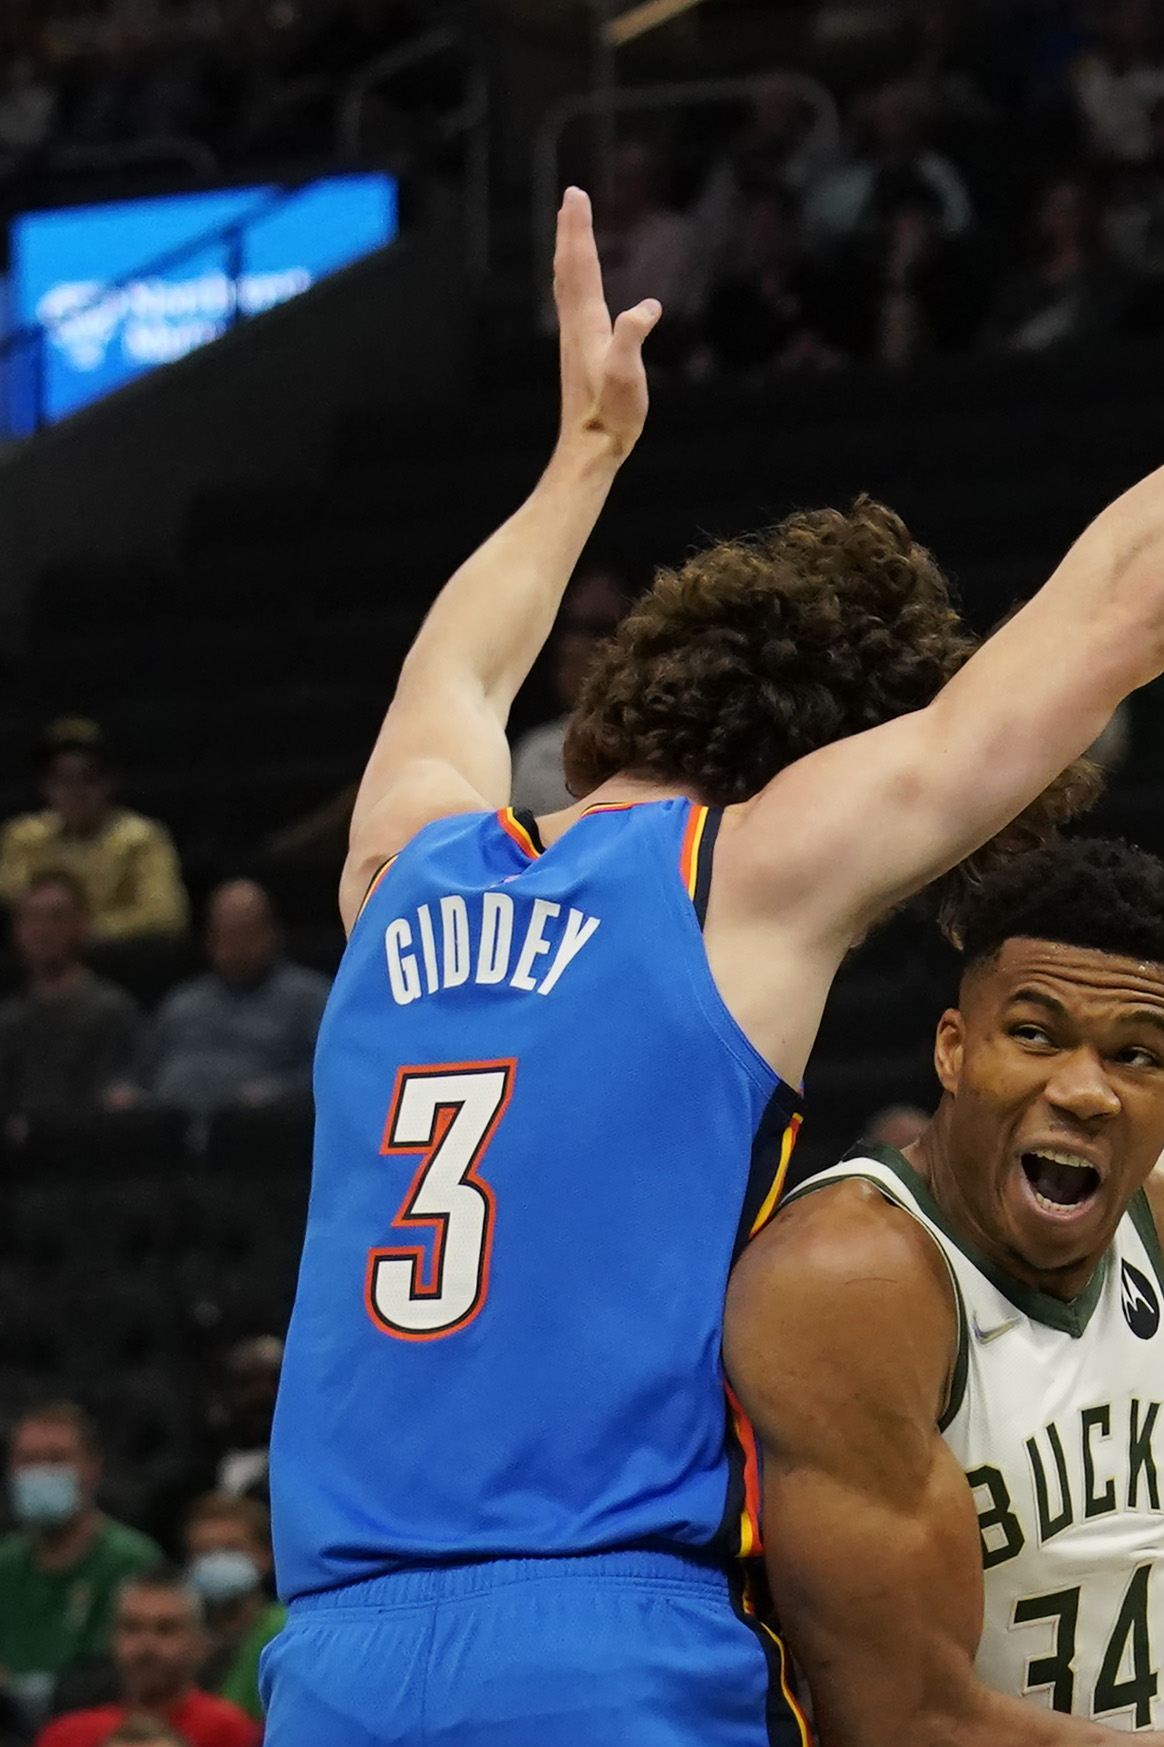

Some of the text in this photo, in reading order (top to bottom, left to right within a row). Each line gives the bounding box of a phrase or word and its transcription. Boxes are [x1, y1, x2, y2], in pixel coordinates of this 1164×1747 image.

[385, 892, 601, 1006] GIDDEY
[365, 1057, 518, 1342] 3
[1008, 1562, 1161, 1732] 34
